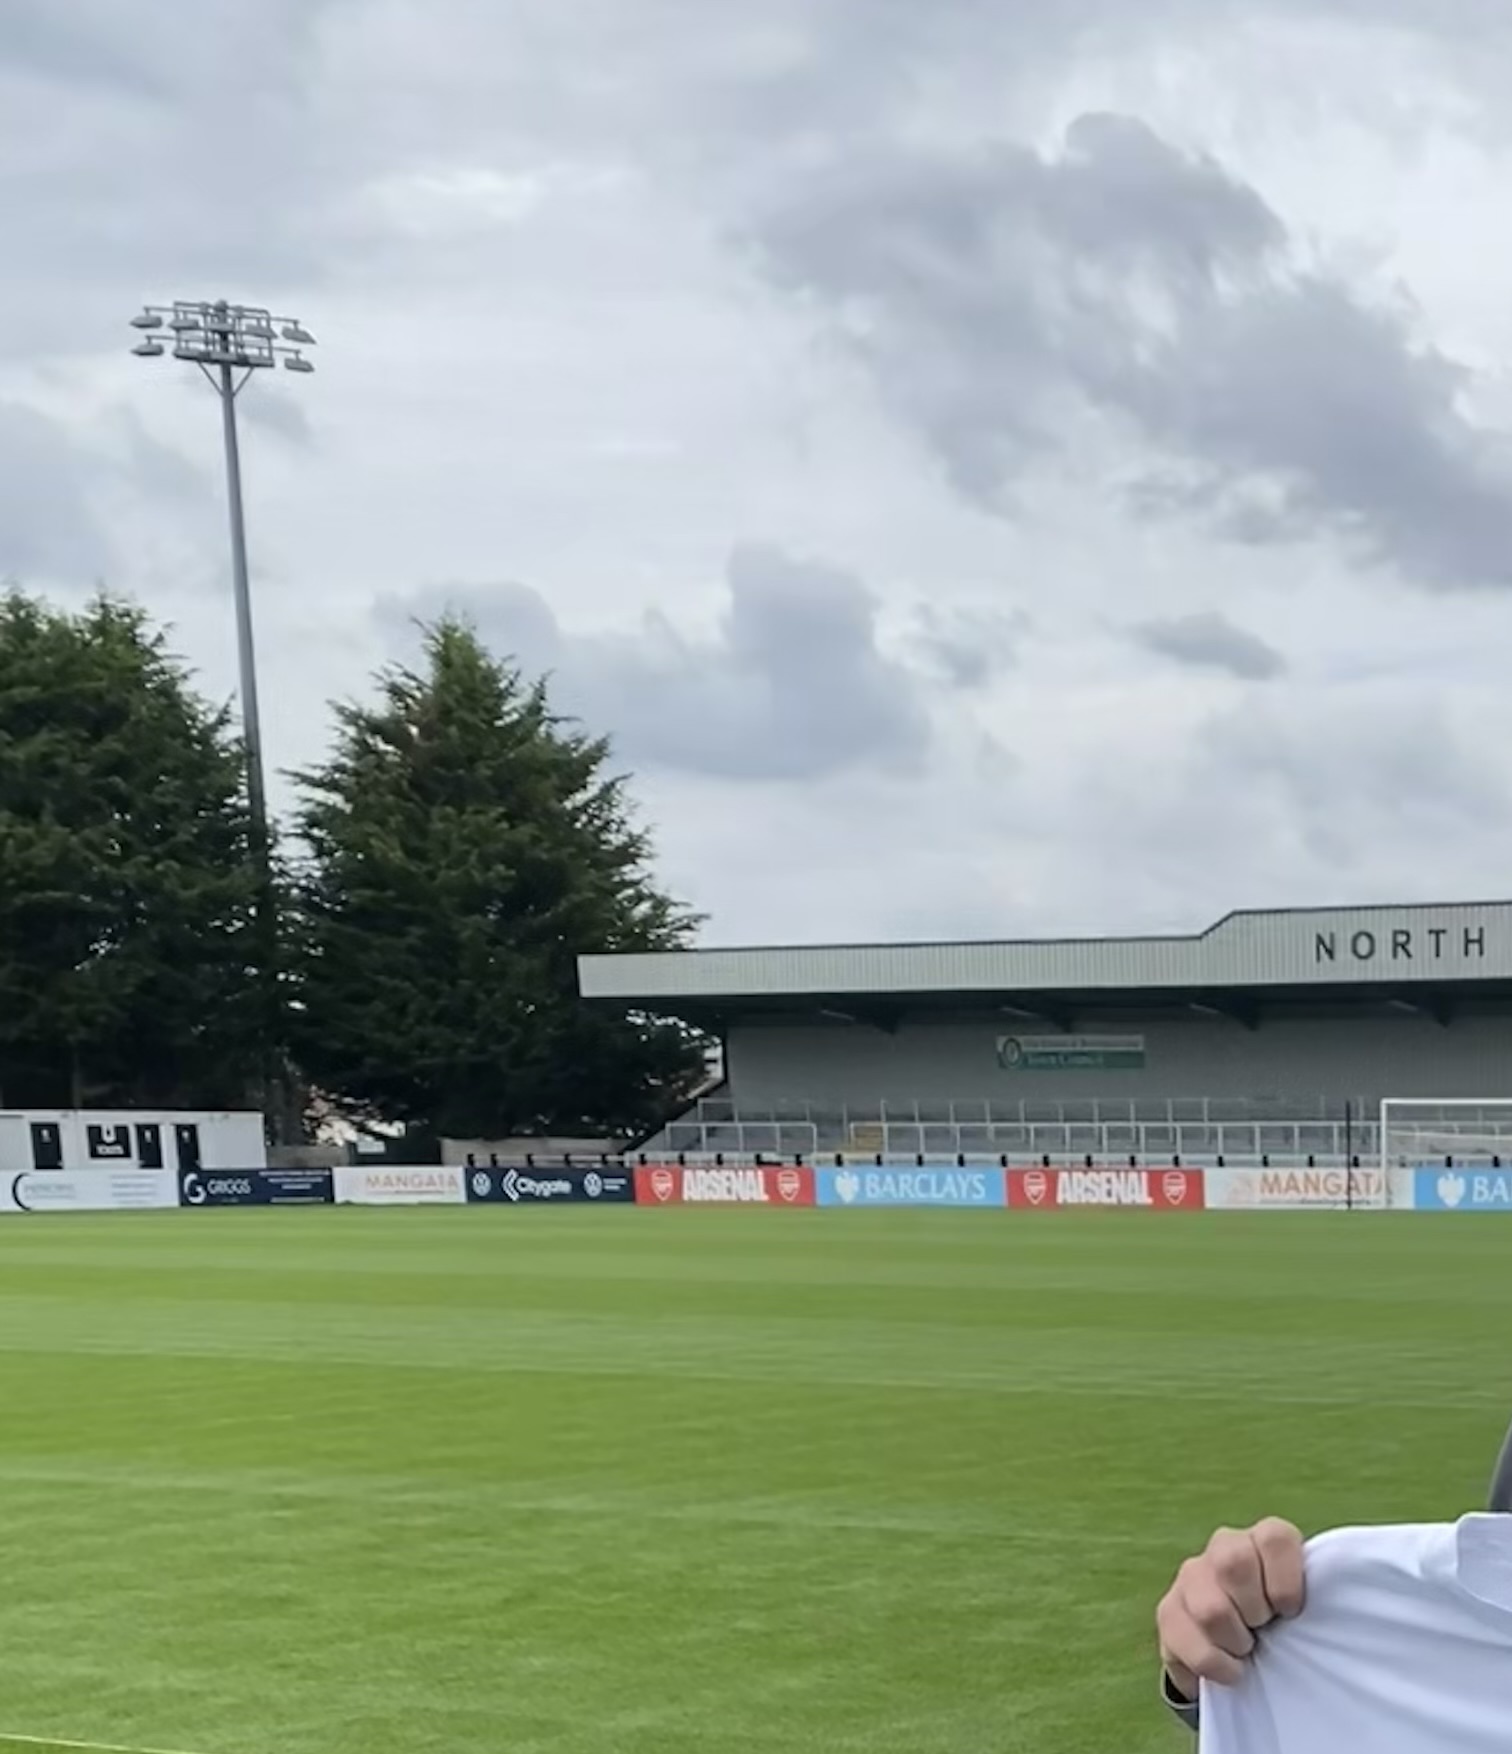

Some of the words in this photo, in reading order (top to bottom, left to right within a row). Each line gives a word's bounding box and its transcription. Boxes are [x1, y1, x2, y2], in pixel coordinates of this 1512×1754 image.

[1315, 927, 1485, 963] NORTH
[207, 1178, 252, 1195] GRIGGS
[365, 1174, 460, 1190] MANGATA
[682, 1169, 769, 1201] ARSENAL
[865, 1173, 986, 1200] BARCLAYS
[1056, 1170, 1153, 1204] ARSENAL
